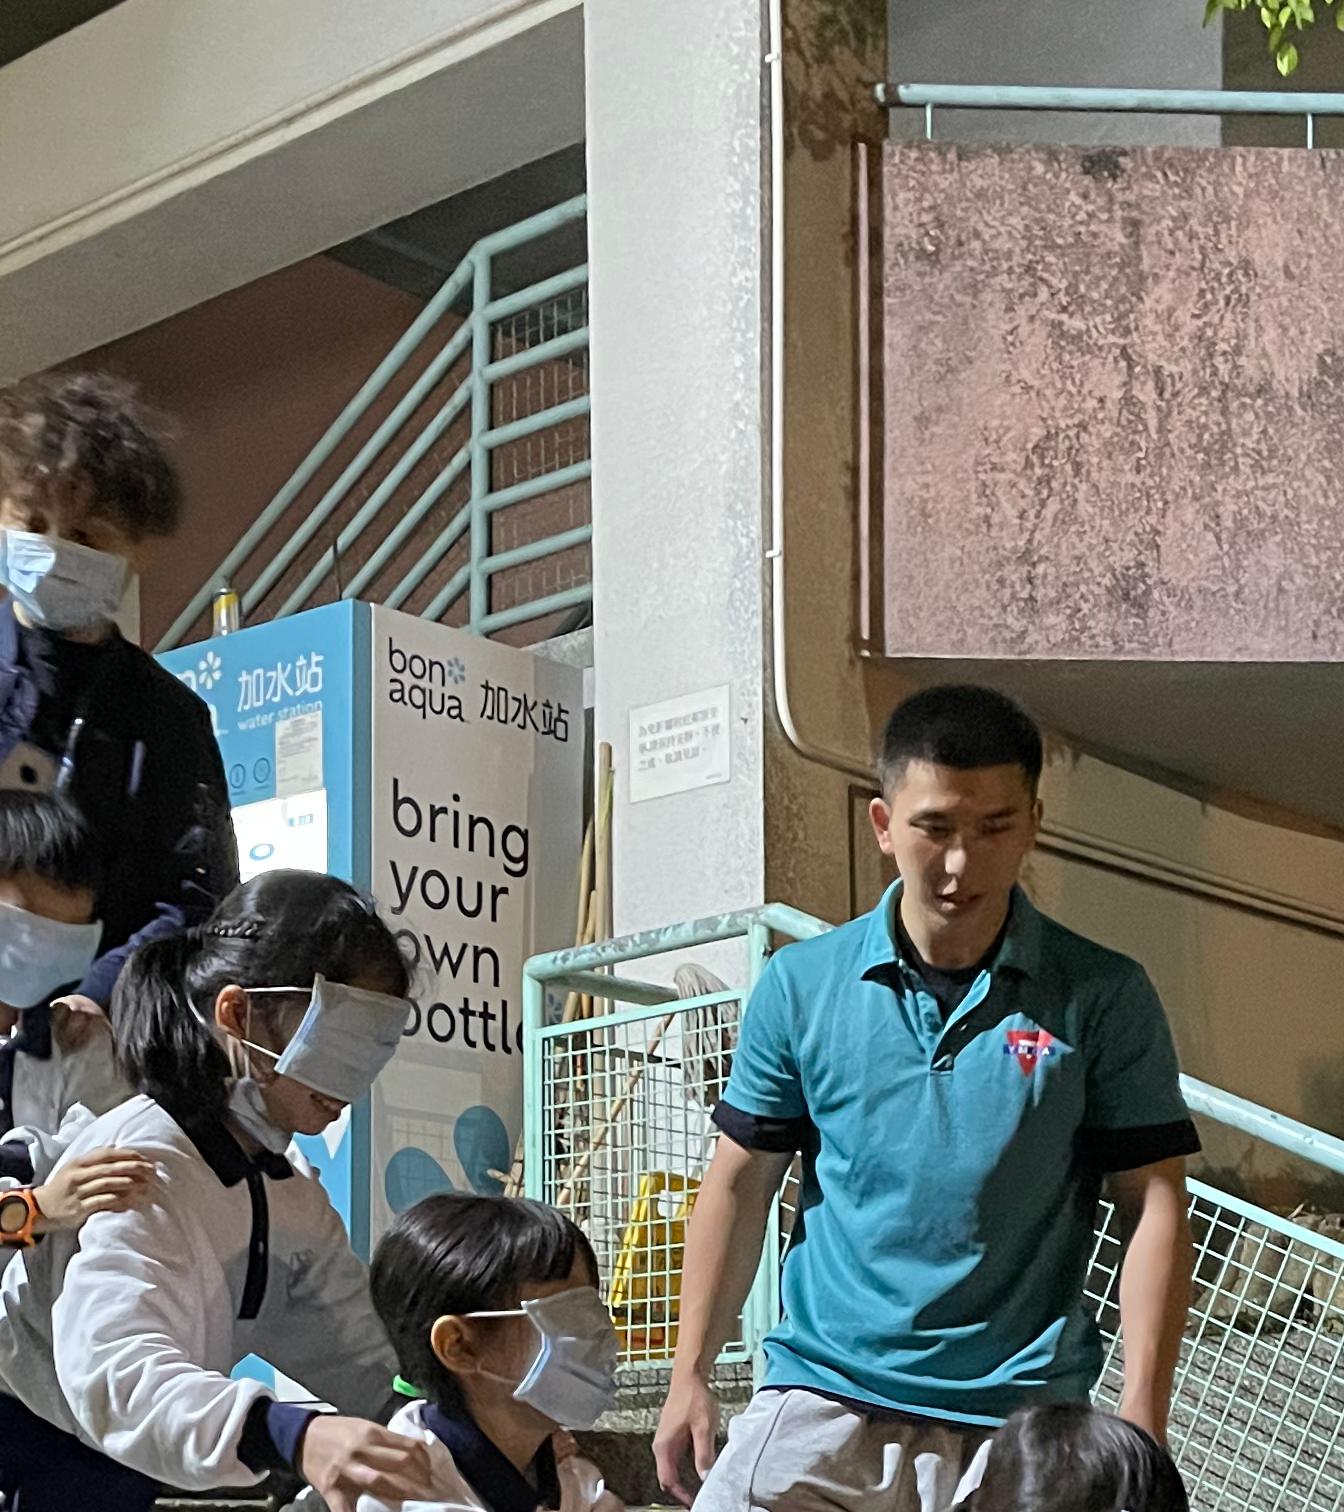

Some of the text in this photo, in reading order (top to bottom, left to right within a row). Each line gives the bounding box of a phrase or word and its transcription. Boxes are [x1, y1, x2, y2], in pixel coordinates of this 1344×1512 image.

[237, 652, 324, 712] 加水站
[389, 637, 446, 687] bon
[237, 711, 275, 730] water
[278, 700, 323, 721] station
[389, 677, 465, 723] aqua
[480, 680, 570, 743] 加水站
[392, 778, 530, 877] bring
[389, 859, 509, 923] your
[393, 928, 500, 988] own
[402, 997, 524, 1055] ottl
